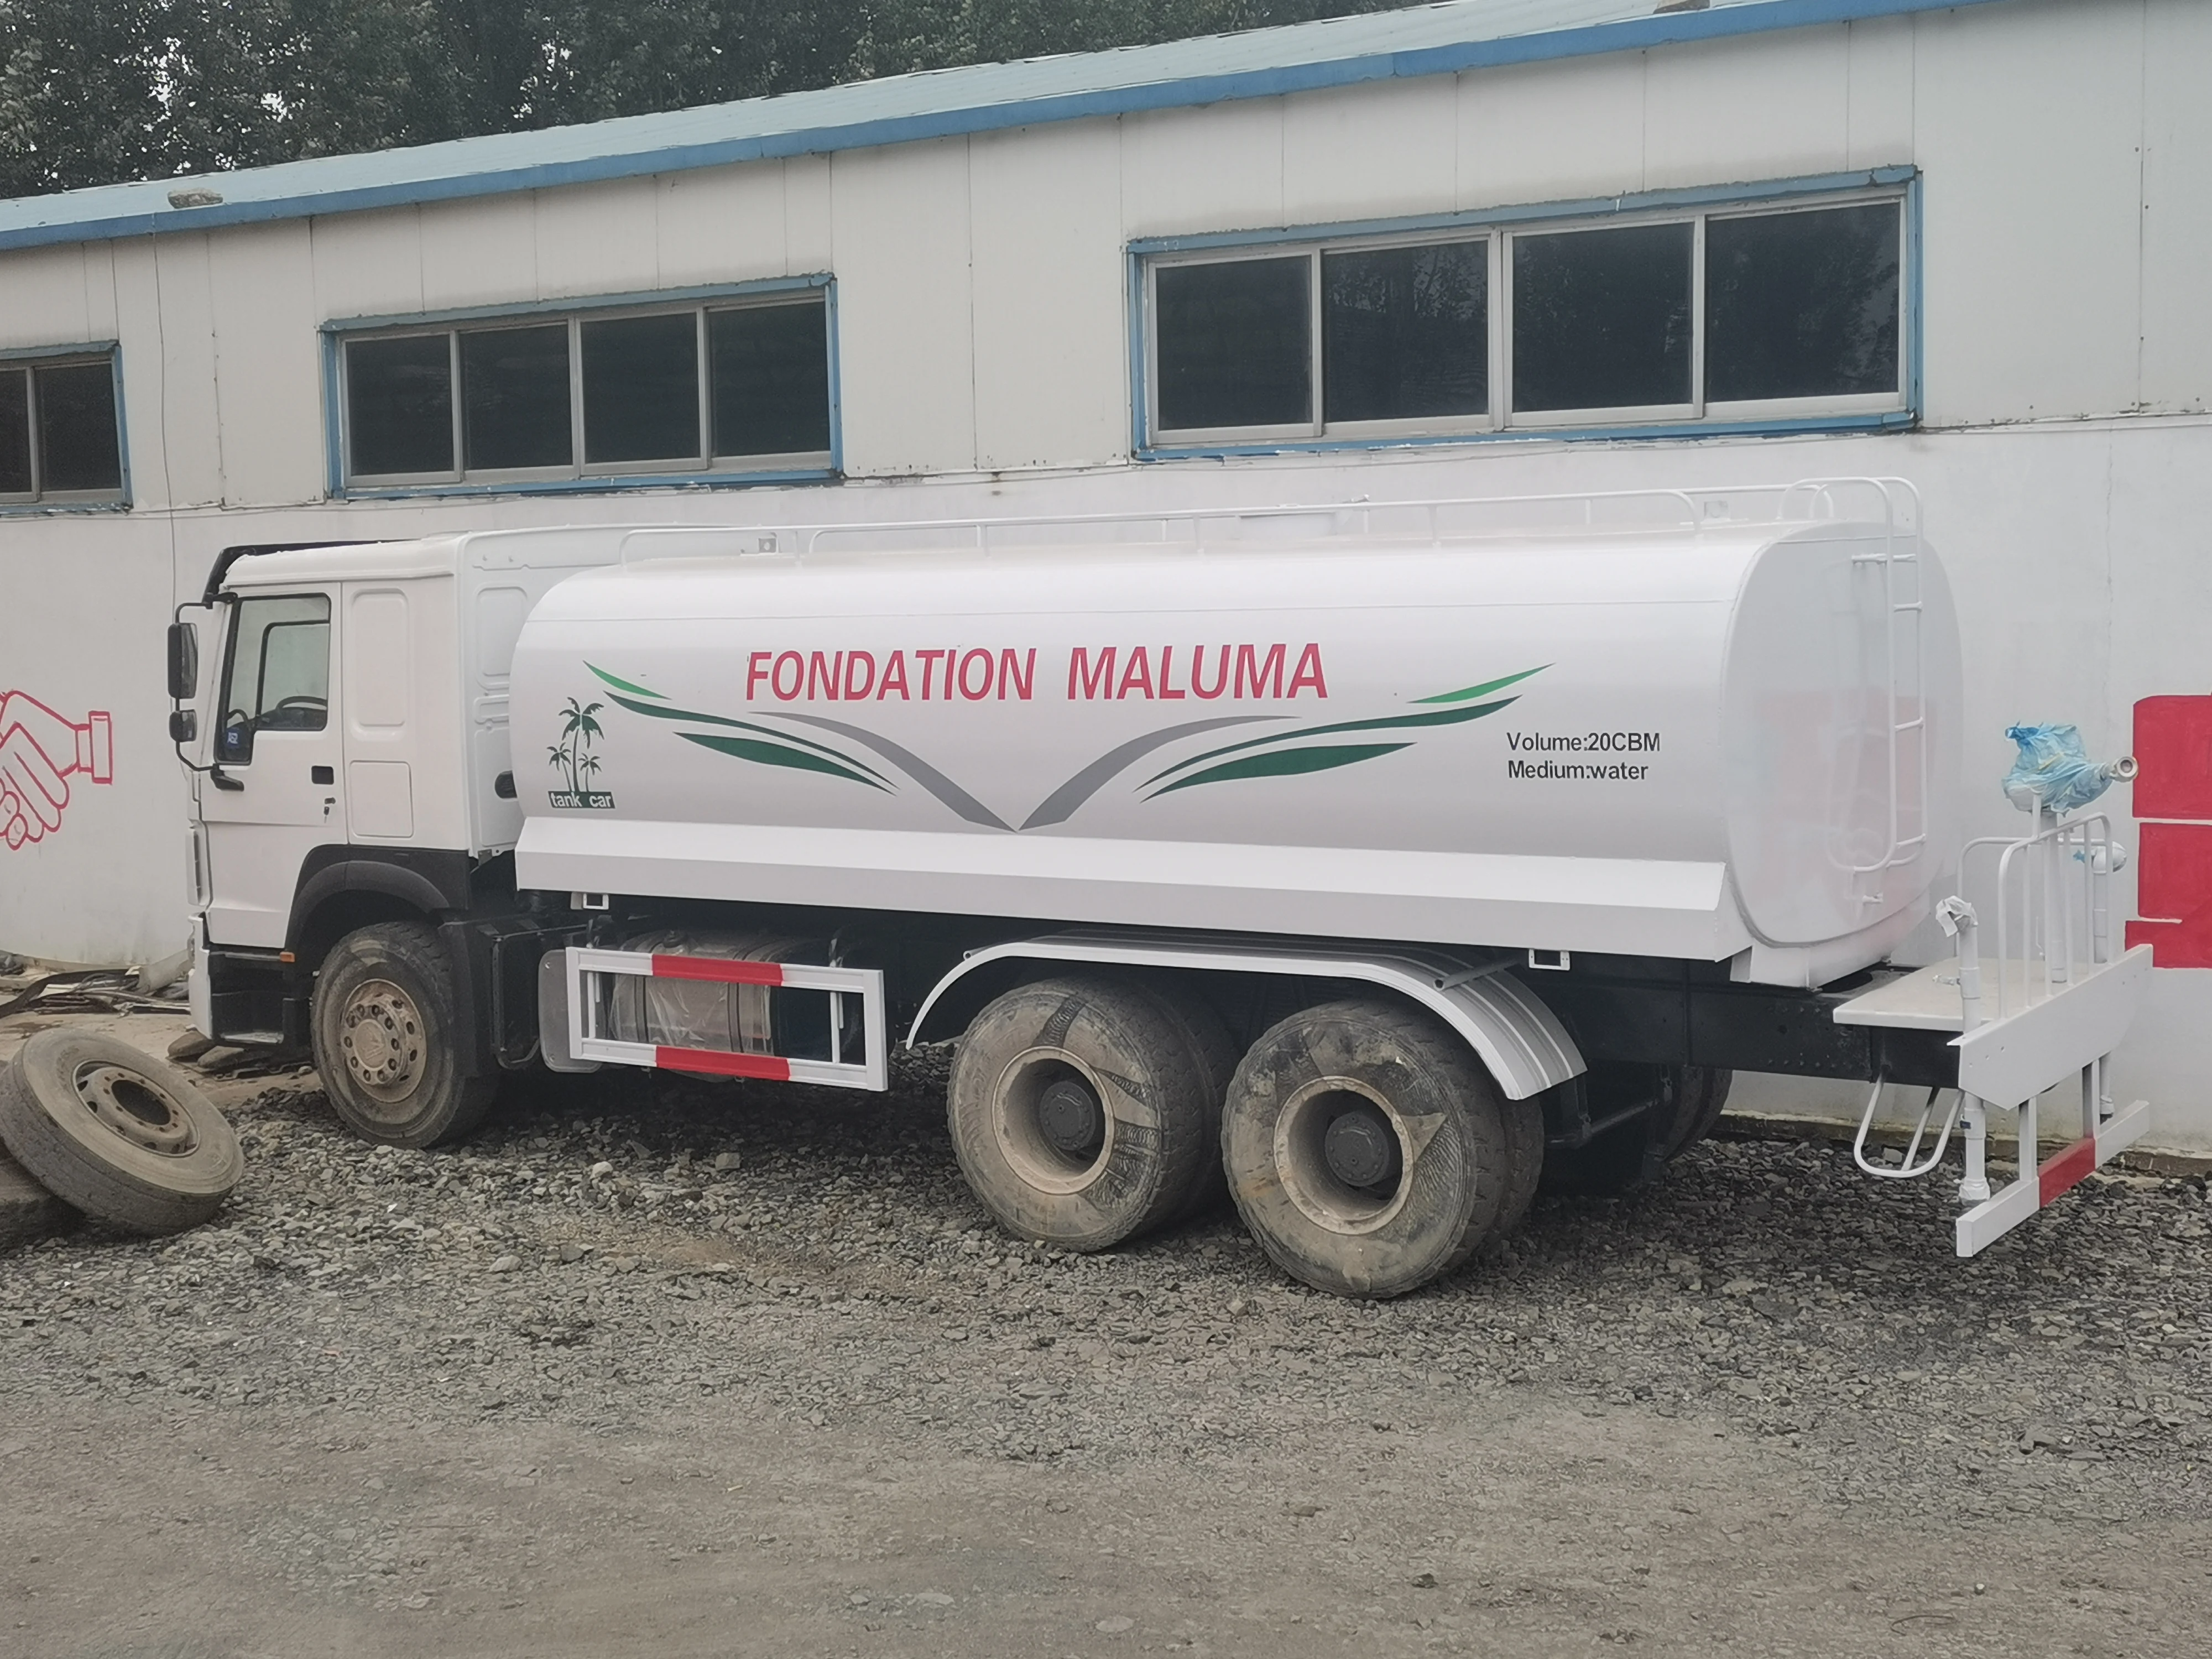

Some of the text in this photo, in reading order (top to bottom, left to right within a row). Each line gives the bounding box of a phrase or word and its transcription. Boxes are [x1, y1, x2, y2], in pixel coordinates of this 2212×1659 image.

[746, 643, 1328, 701] FONDATION MALUMA
[1506, 732, 1660, 752] Volume:20CBM
[1508, 760, 1649, 780] Medium:water
[550, 792, 612, 807] tank car
